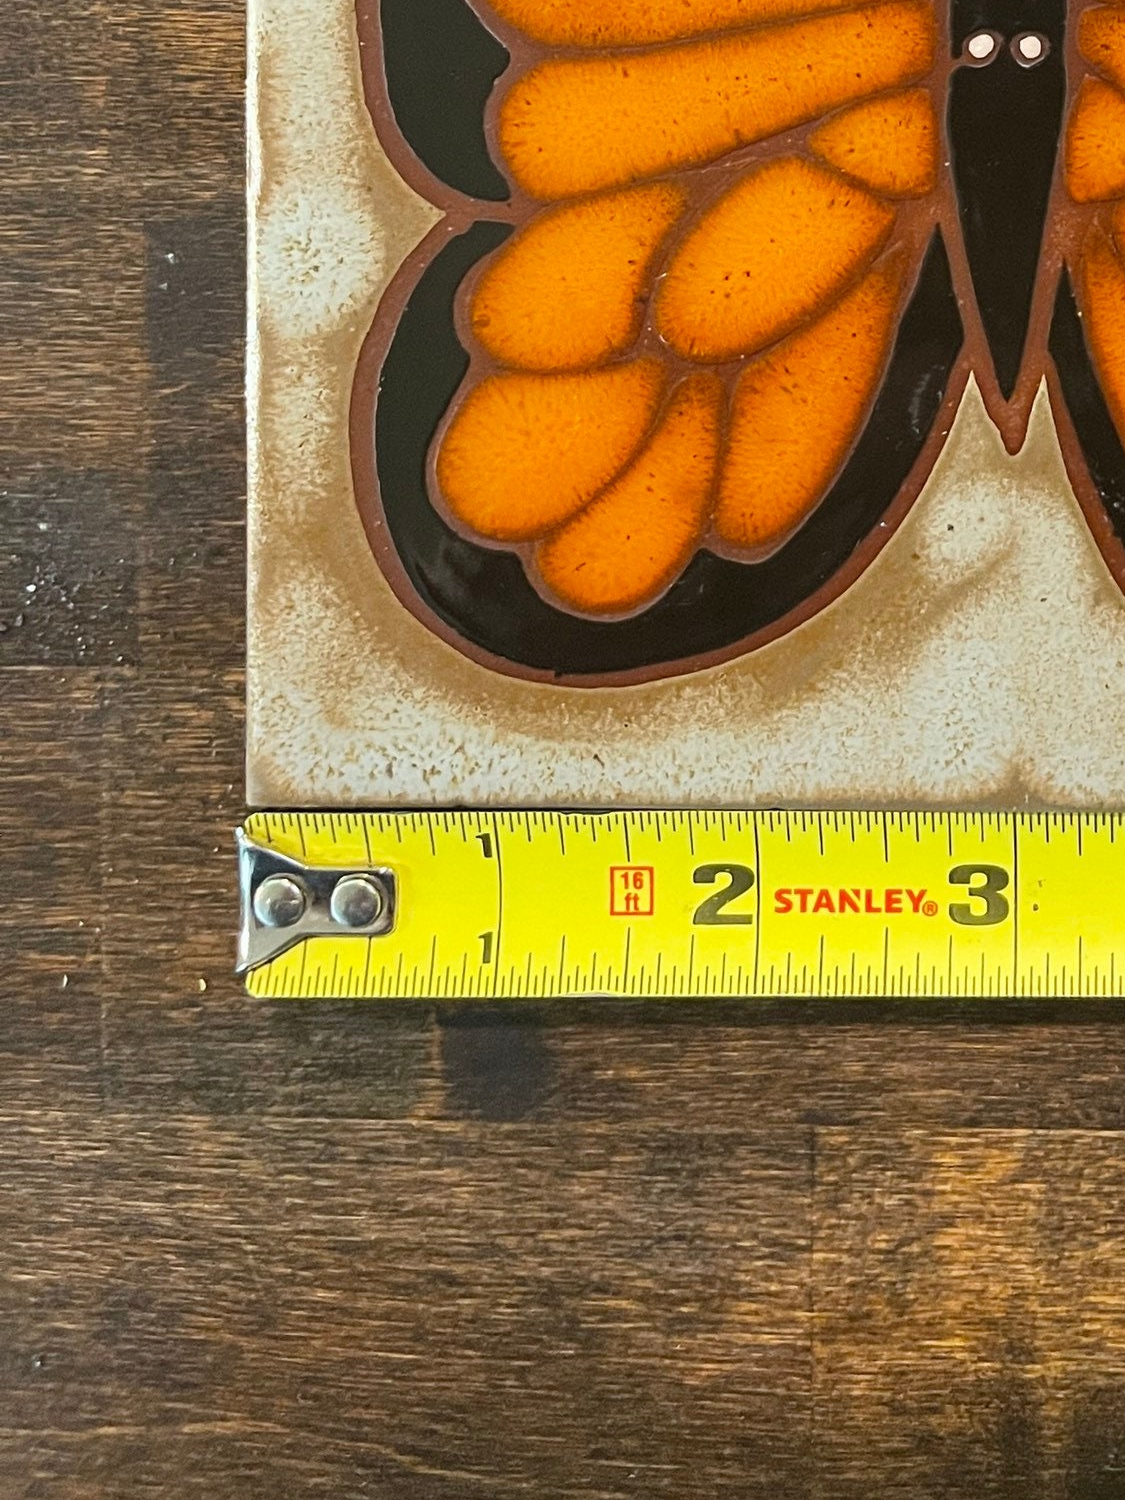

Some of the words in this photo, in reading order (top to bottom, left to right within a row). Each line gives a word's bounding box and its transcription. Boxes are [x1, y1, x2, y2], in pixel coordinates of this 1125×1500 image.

[475, 832, 493, 858] 1
[620, 871, 644, 890] 16
[692, 864, 755, 926] 2
[948, 864, 1010, 926] 3
[624, 892, 640, 911] ft
[478, 931, 493, 964] 1
